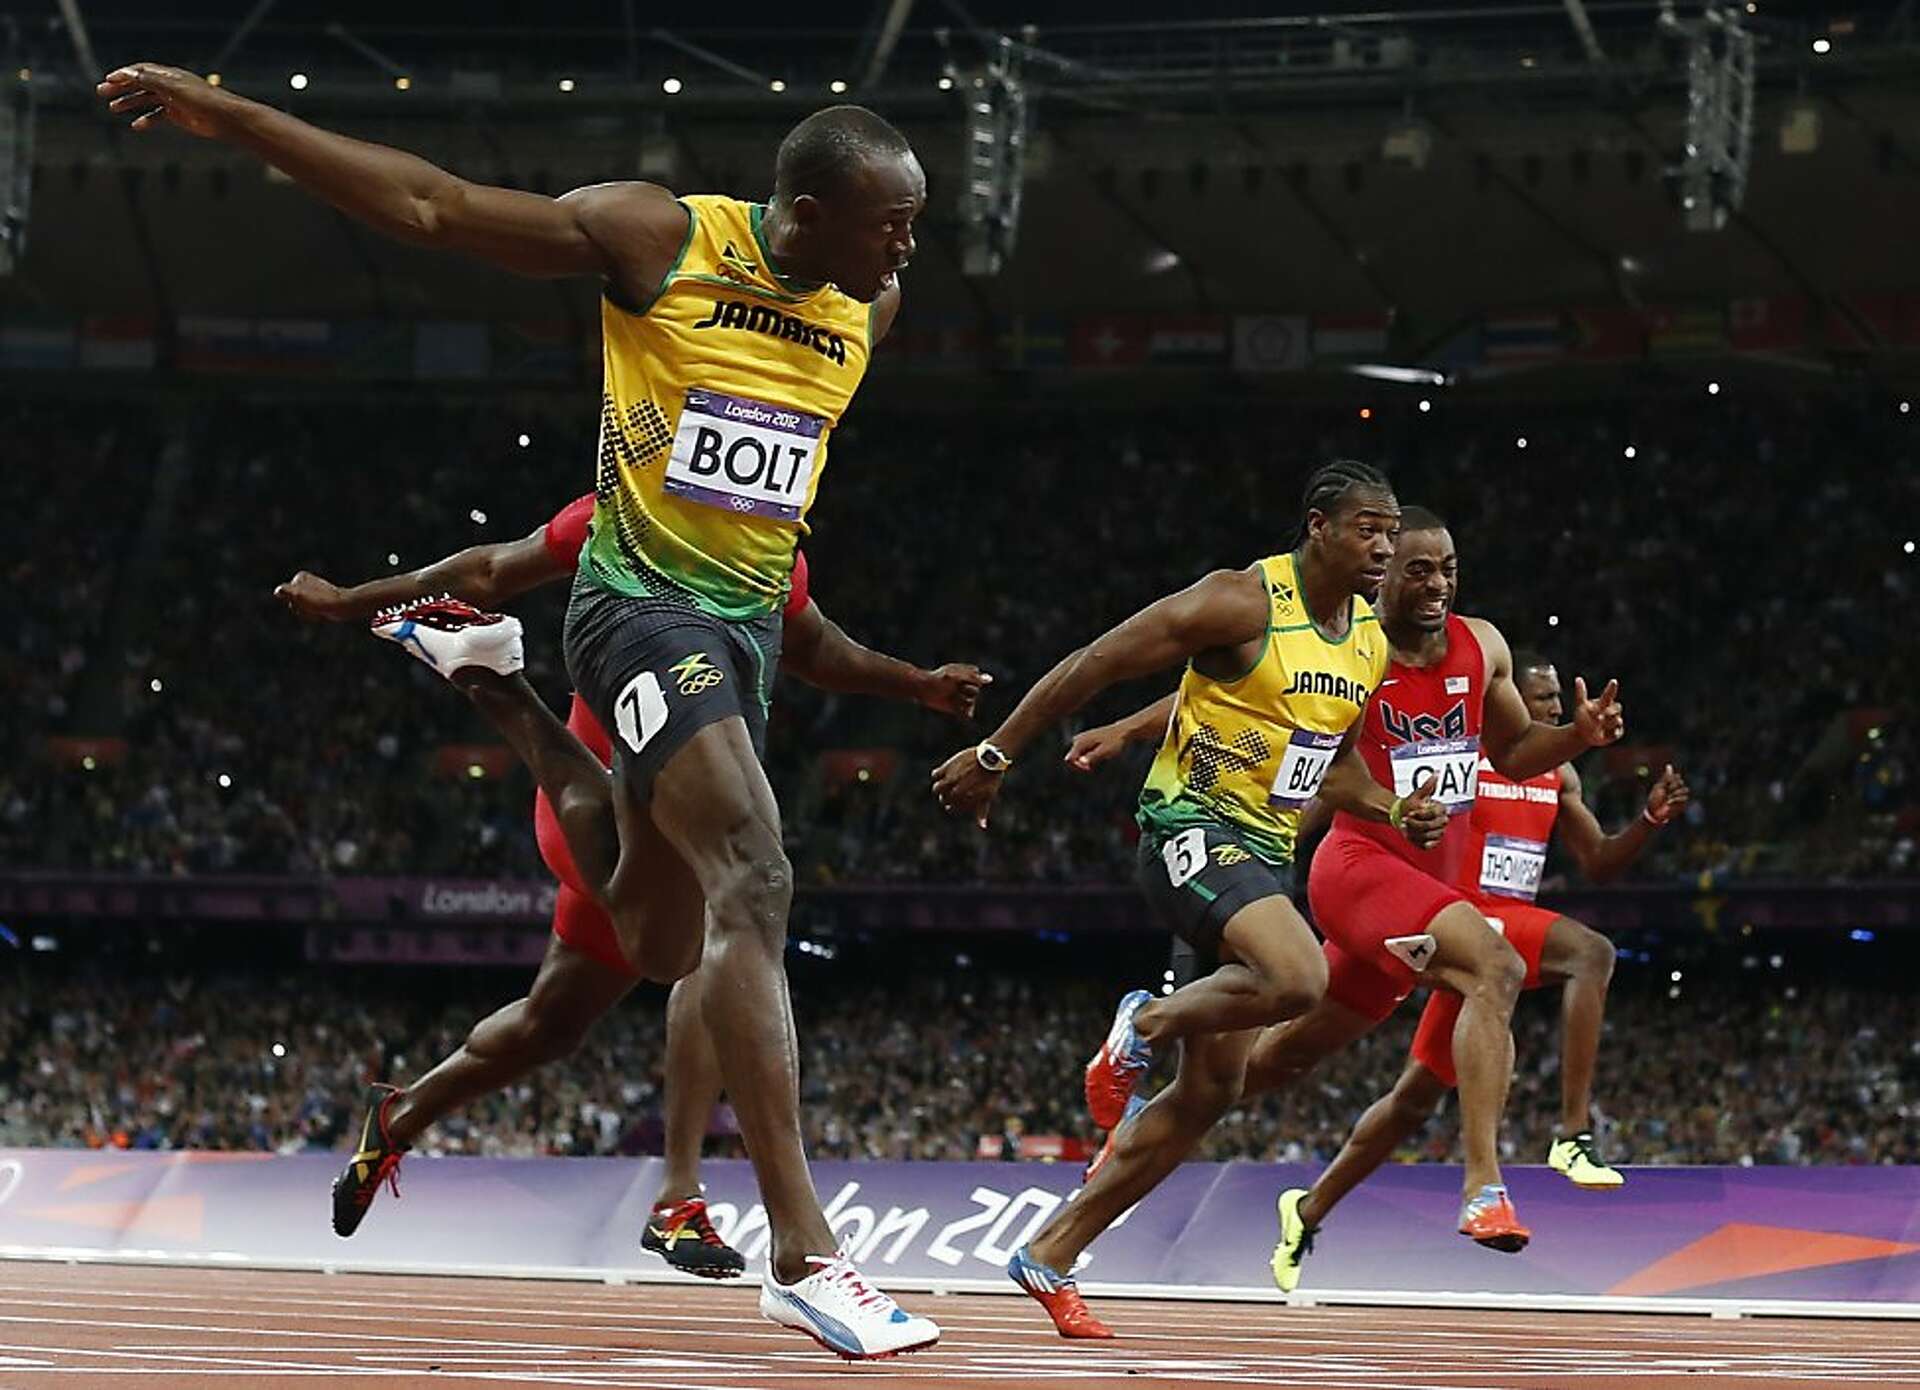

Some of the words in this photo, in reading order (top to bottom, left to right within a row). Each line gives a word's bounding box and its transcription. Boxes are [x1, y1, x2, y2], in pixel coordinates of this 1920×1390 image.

[693, 301, 845, 366] JAMAICA
[724, 401, 773, 424] London
[688, 426, 808, 494] BOLT
[1281, 671, 1370, 708] JAMAIC
[620, 686, 644, 742] 7
[1380, 698, 1466, 744] USA
[1176, 836, 1192, 877] 5
[422, 882, 531, 914] London
